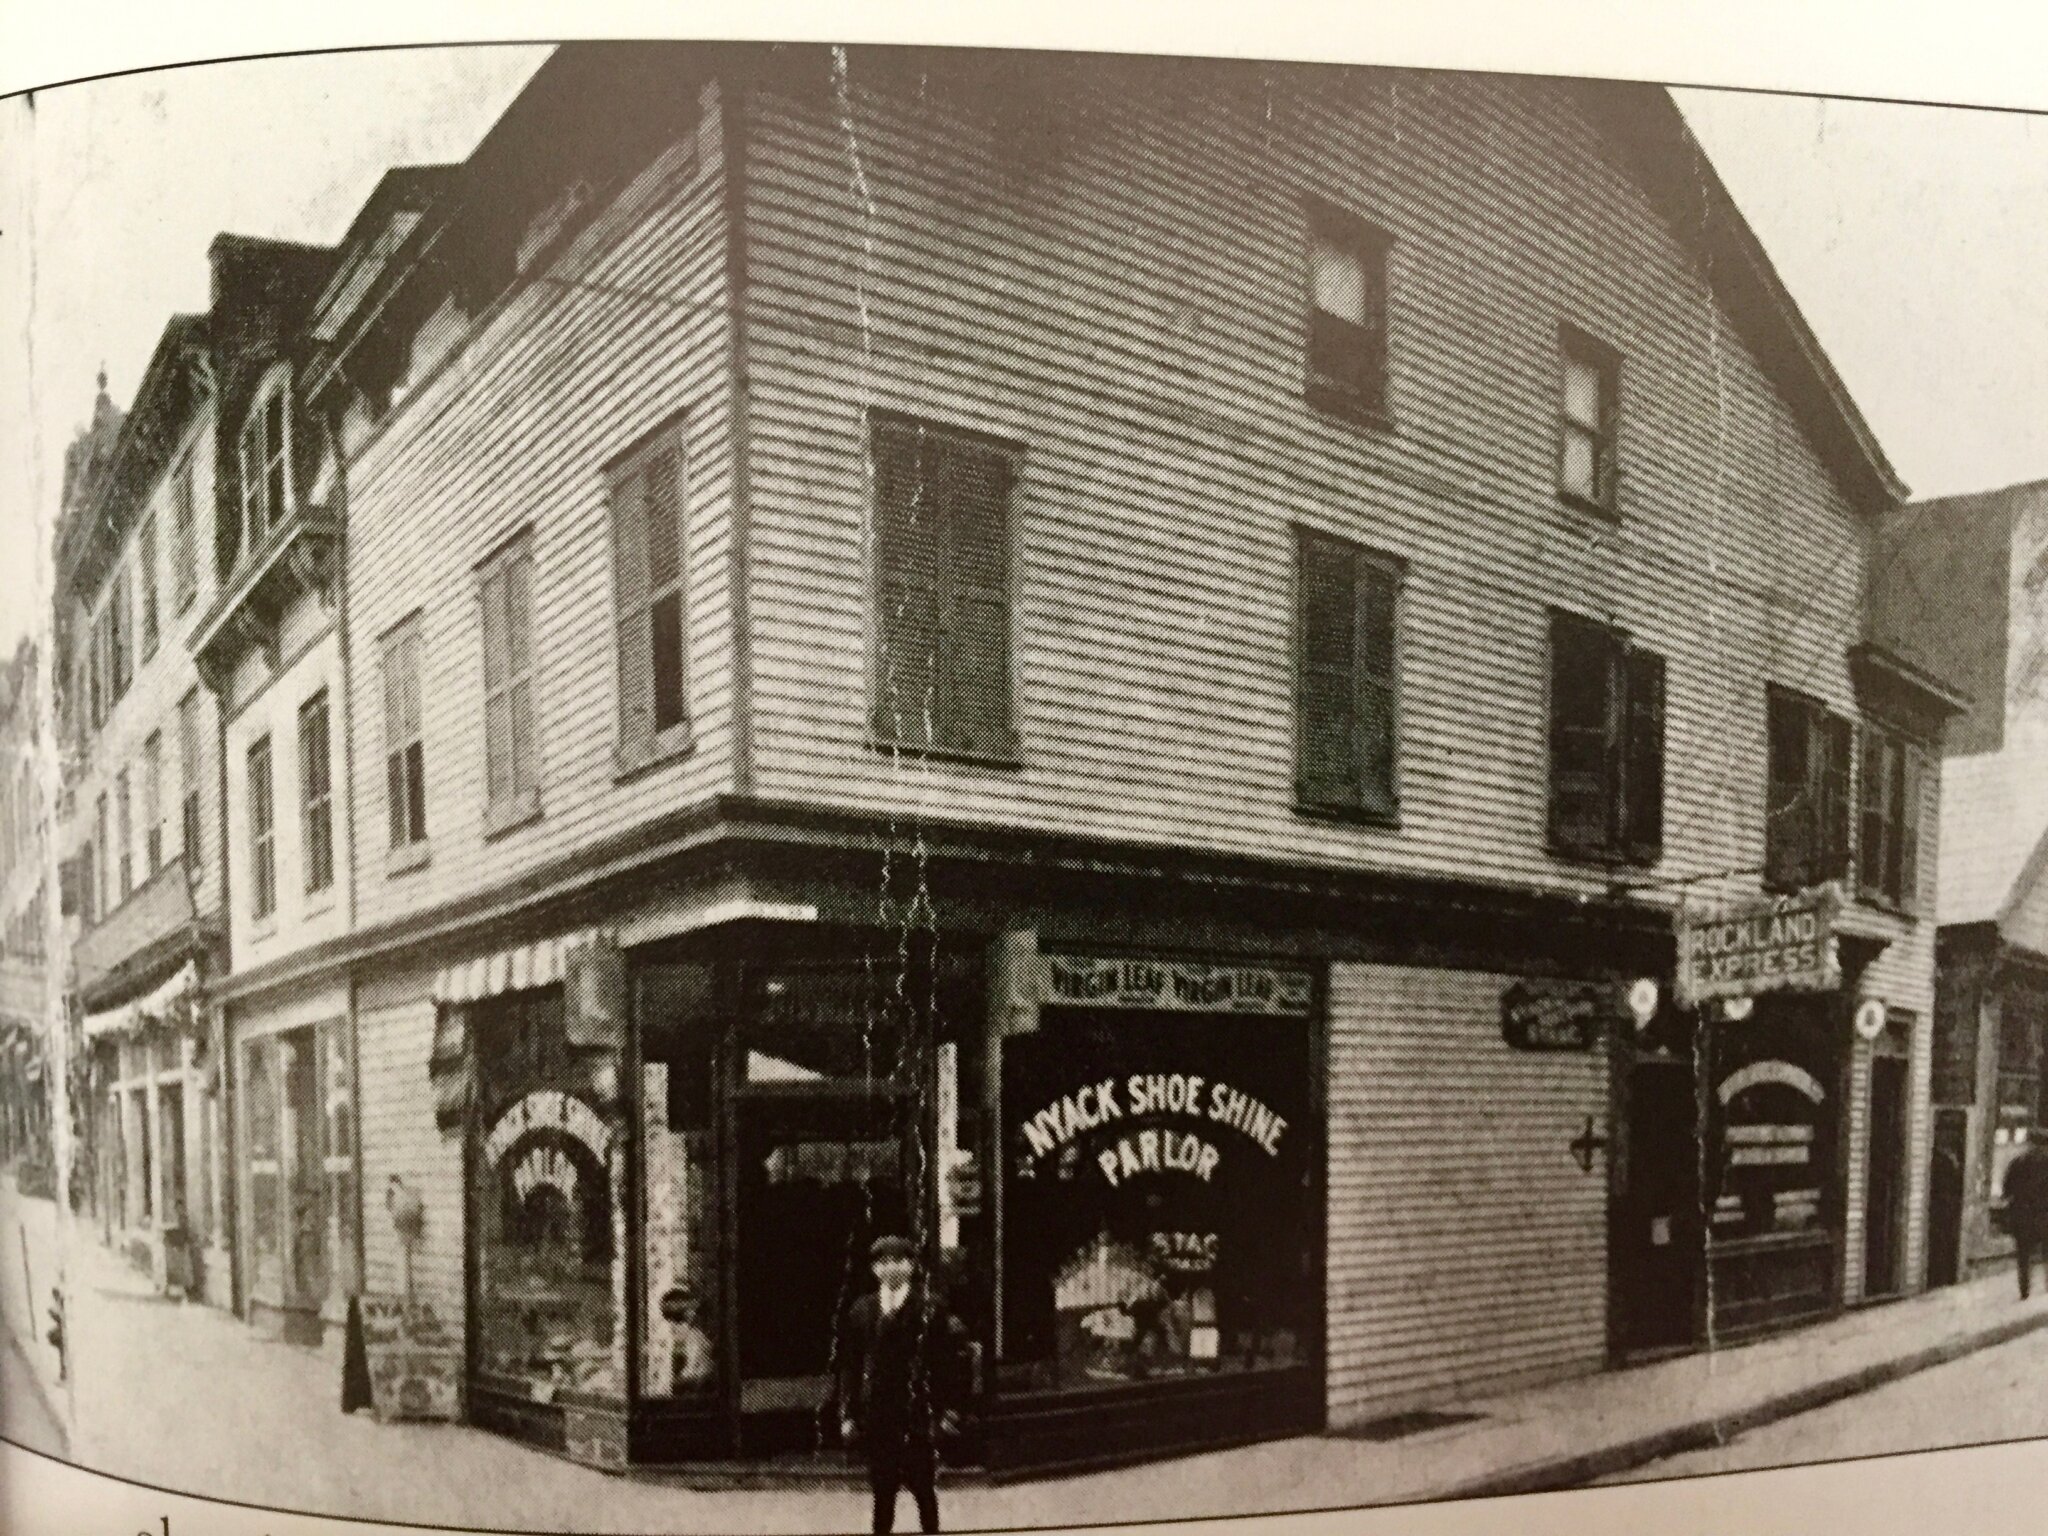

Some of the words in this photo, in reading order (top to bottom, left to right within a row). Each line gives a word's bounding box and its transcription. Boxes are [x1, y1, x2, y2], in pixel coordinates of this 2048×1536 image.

[1691, 913, 1816, 954] ROCKLAND
[1691, 944, 1816, 982] EXPRESS
[1022, 1077, 1123, 1158] NYACK
[1127, 1073, 1205, 1116] SHOE
[1208, 1083, 1288, 1157] SHINE
[1098, 1128, 1220, 1188] PARLOR
